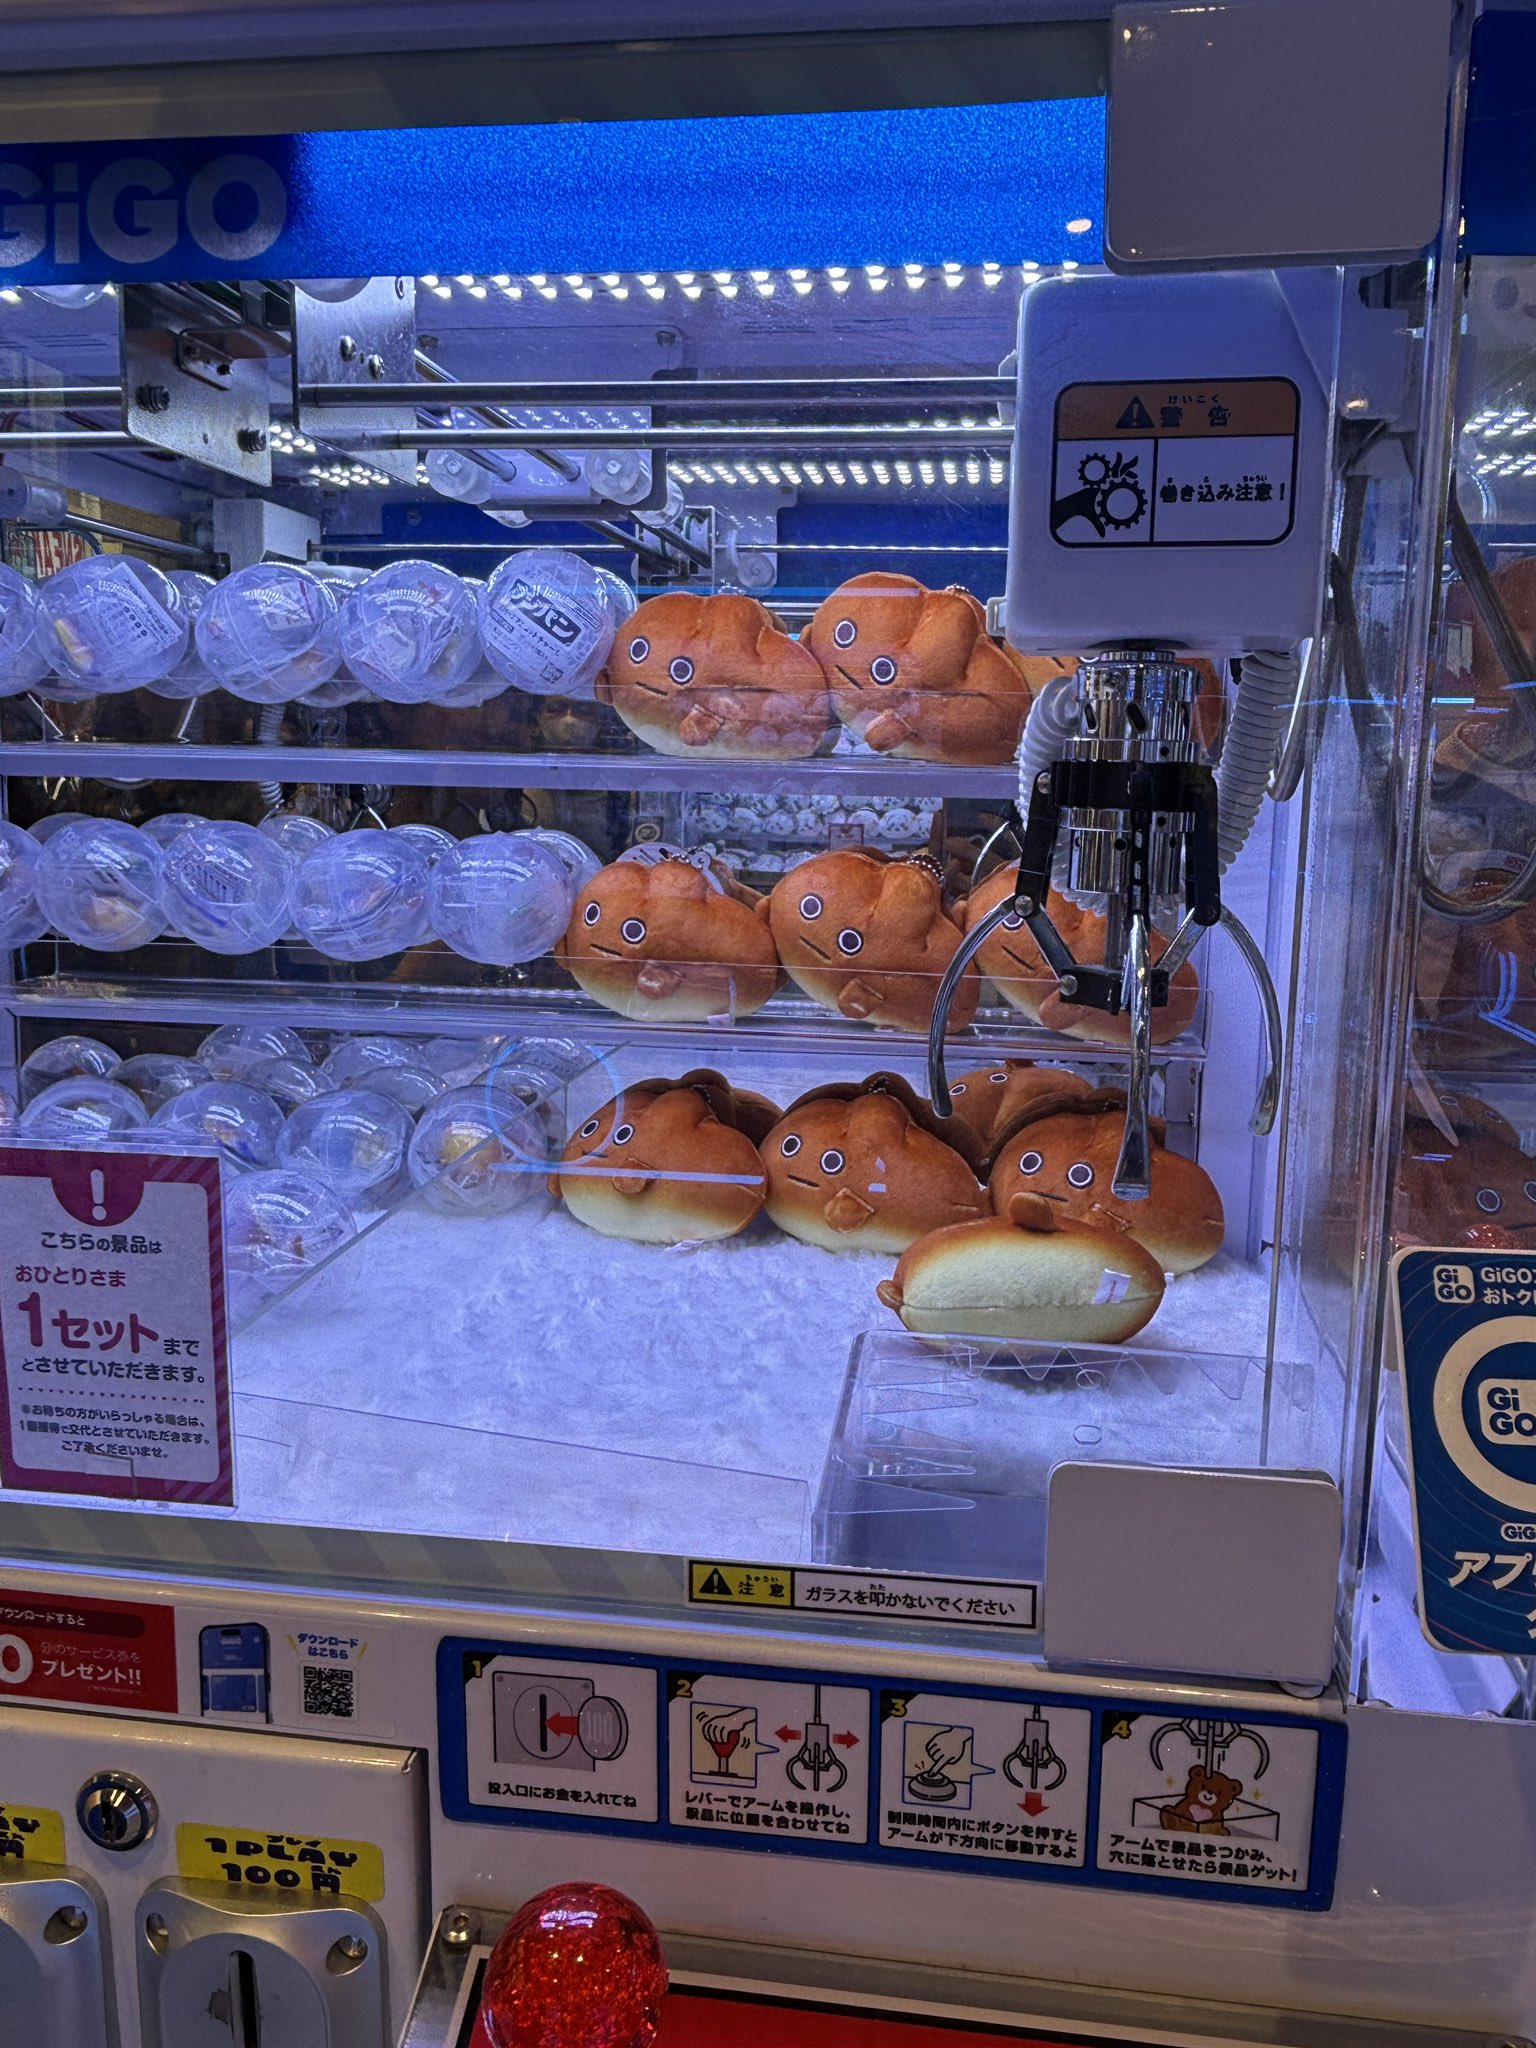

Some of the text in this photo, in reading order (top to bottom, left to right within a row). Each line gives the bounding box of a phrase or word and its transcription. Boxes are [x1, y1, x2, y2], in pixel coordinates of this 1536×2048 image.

[41, 1231, 163, 1254] こちらの景品は
[15, 1264, 127, 1287] おひとりさま
[1483, 1288, 1536, 1306] おトク
[22, 1356, 205, 1383] とさせていただきます。
[1448, 1551, 1536, 1590] アプ
[806, 1586, 1016, 1616] ガラスを叩かないでください
[297, 1632, 359, 1648] ダウンロード
[472, 1659, 482, 1678] 1
[676, 1679, 692, 1697] 2
[890, 1698, 907, 1717] 3
[1112, 1719, 1131, 1739] 4
[488, 1781, 637, 1808] 投入口にお金を入れてね
[685, 1790, 850, 1818] レバーでアームを操作し、
[685, 1806, 850, 1834] 景品に位置を合わせてね
